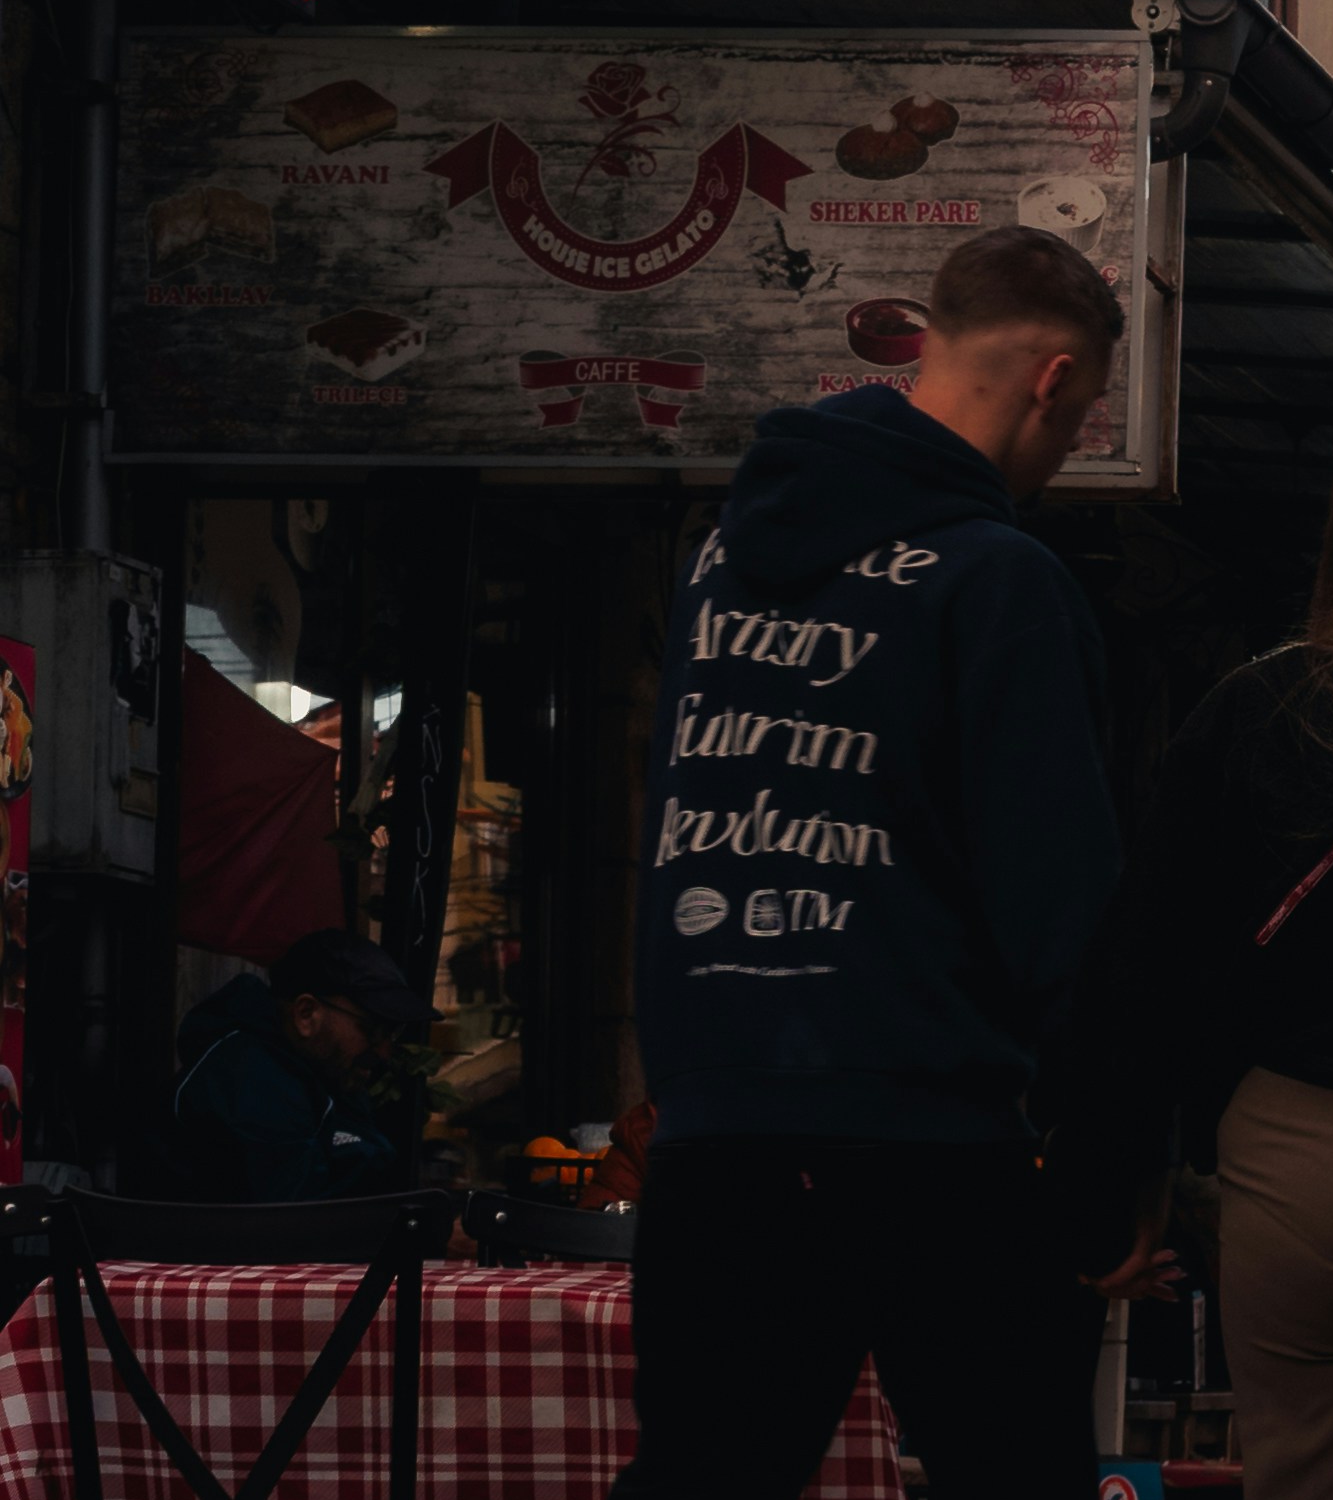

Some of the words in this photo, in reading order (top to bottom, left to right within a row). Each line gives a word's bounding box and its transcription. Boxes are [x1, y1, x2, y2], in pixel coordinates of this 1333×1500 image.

[280, 164, 390, 185] RAVANI
[809, 201, 909, 223] SHEKER
[915, 201, 980, 223] PARE
[522, 214, 590, 275] HOUSE
[592, 256, 631, 279] ICE
[634, 208, 716, 276] GELATO
[145, 285, 274, 306] BAKLLAV
[575, 361, 641, 382] CAFFE
